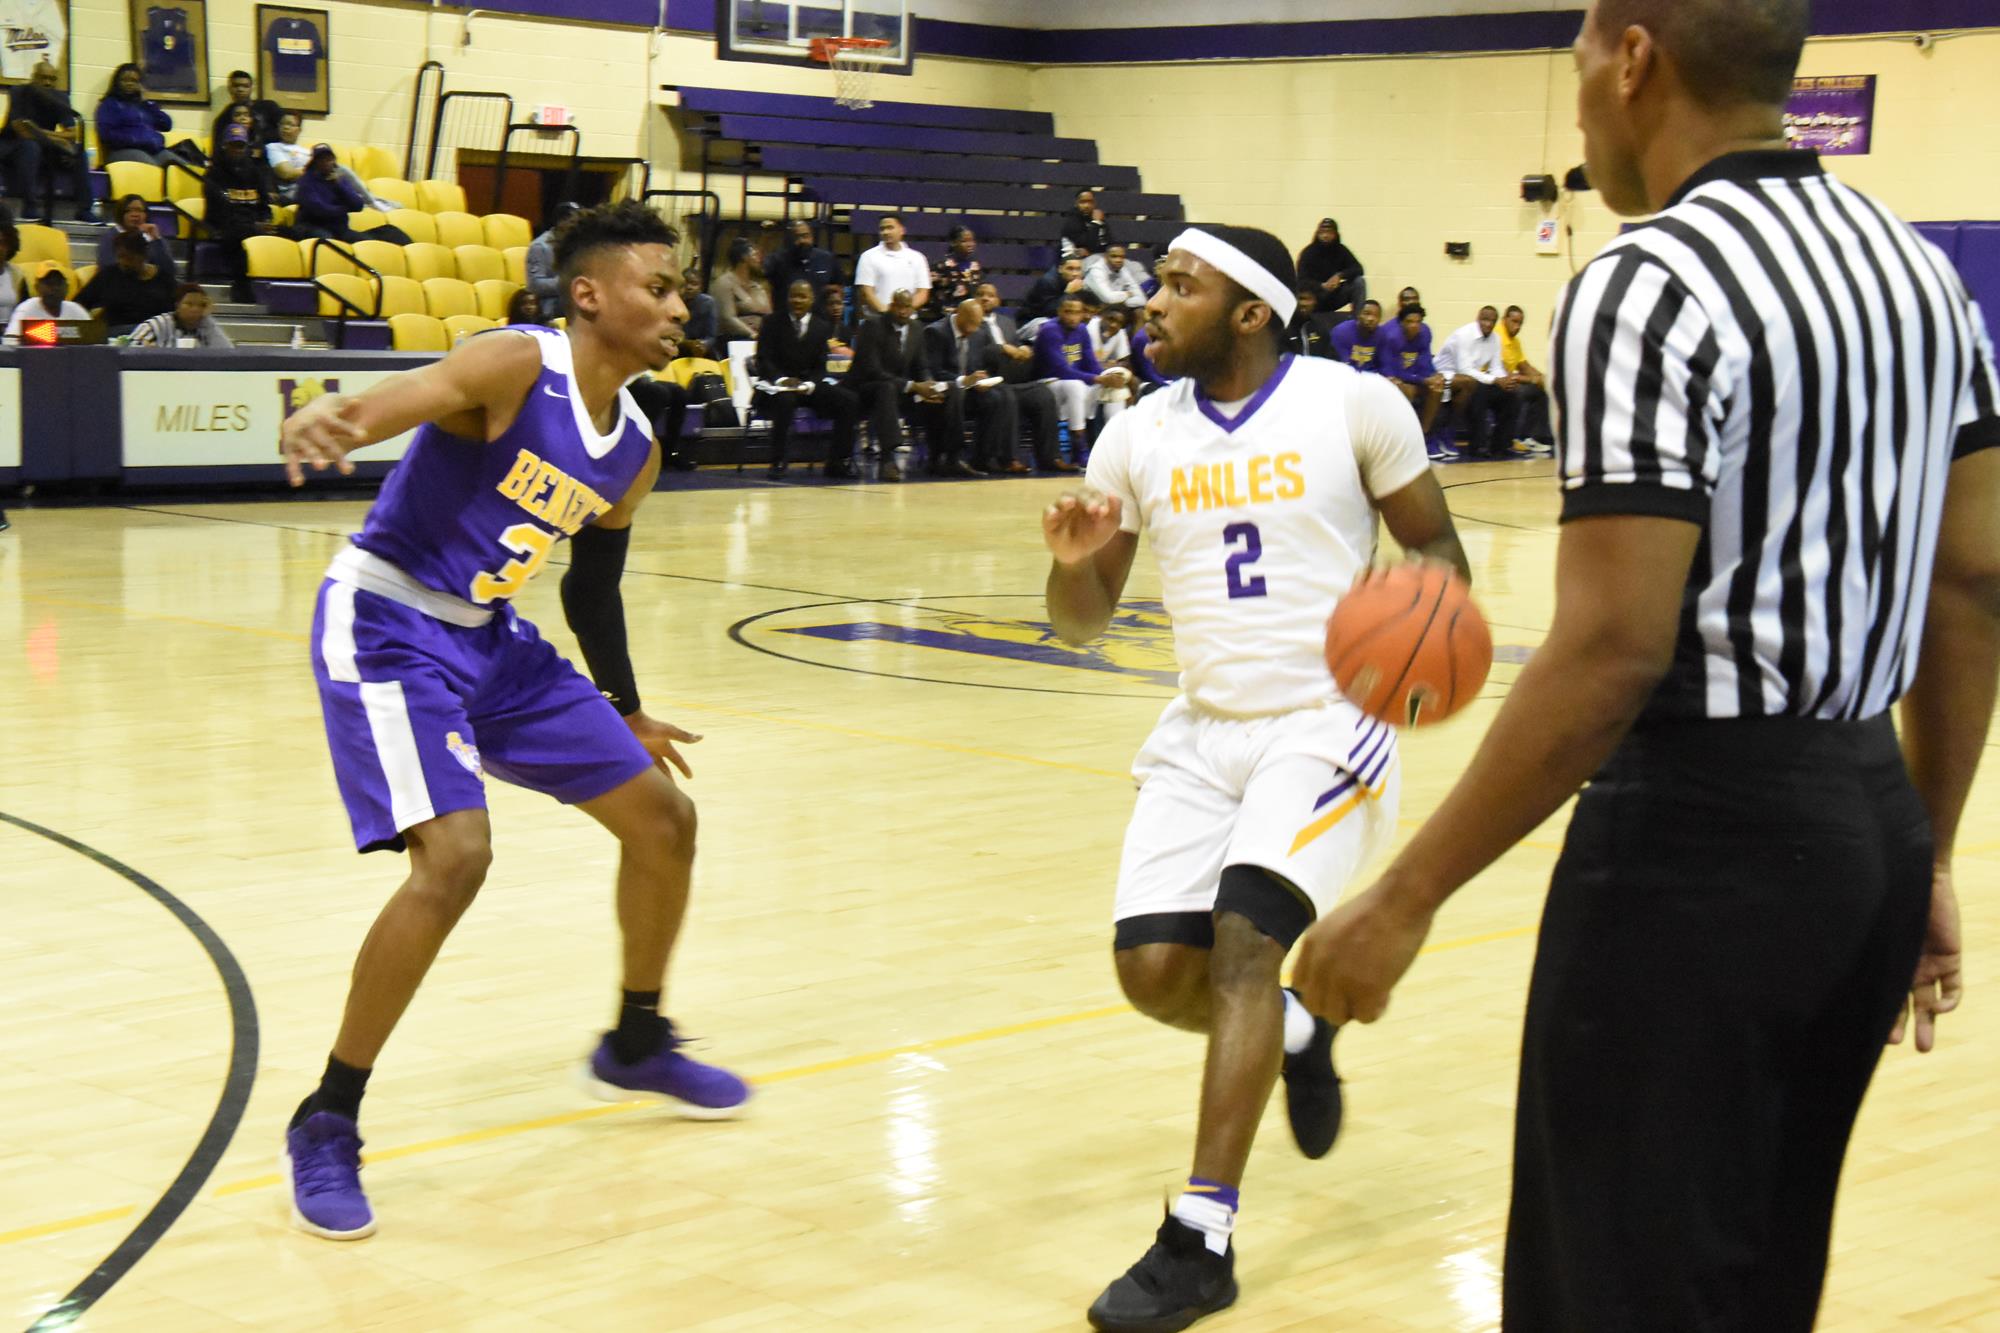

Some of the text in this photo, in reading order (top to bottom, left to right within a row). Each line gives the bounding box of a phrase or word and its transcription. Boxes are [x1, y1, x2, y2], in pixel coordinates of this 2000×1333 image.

[544, 106, 566, 125] EXIT
[156, 404, 249, 432] MILES
[1169, 451, 1306, 513] MILES
[1223, 521, 1268, 599] 2
